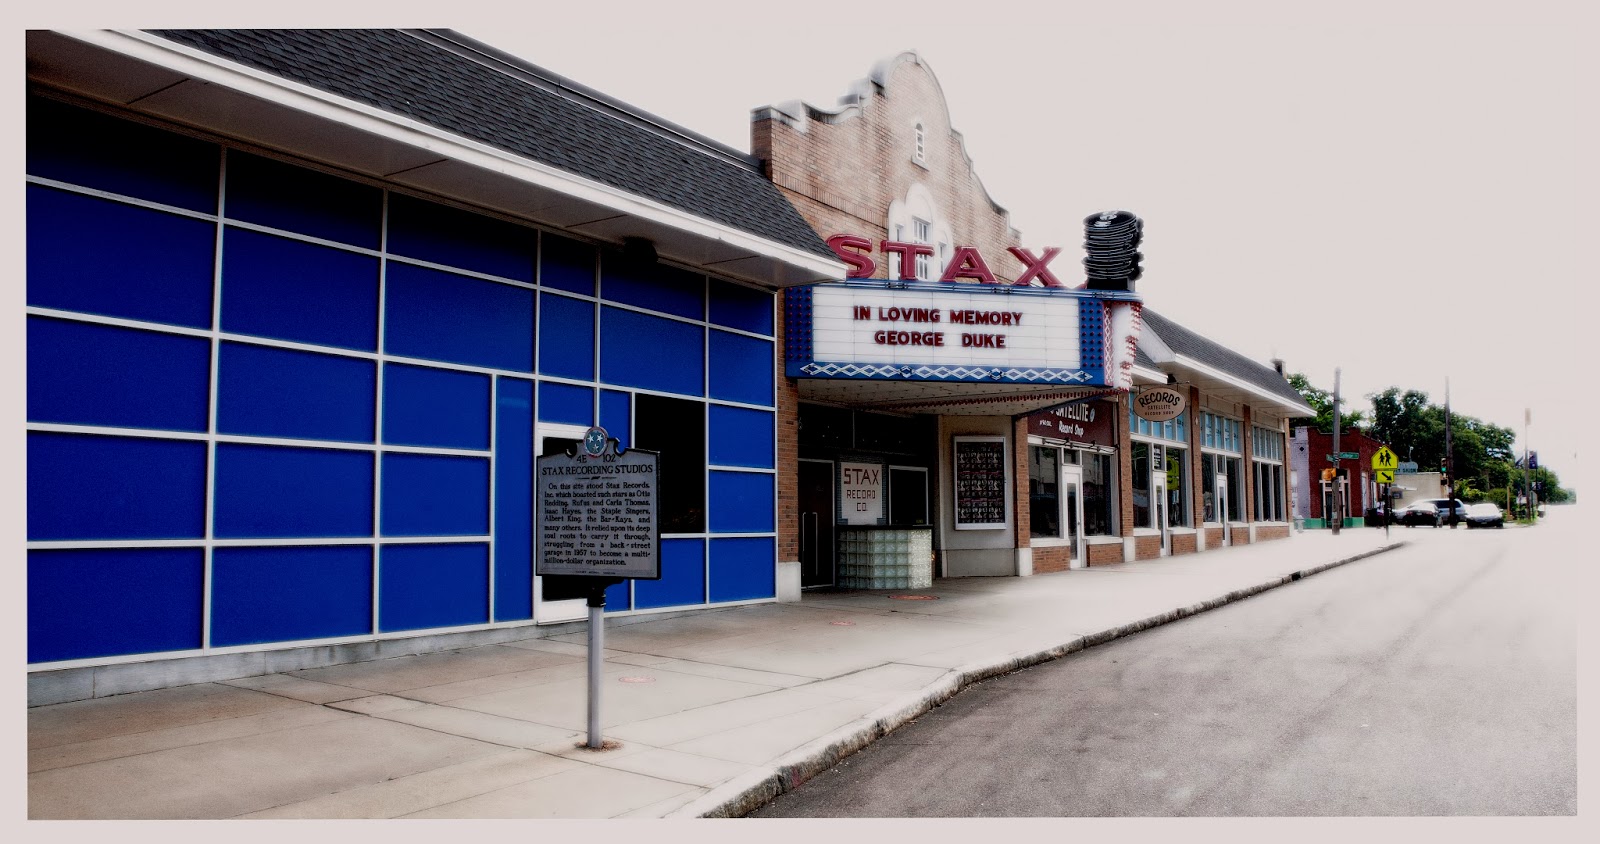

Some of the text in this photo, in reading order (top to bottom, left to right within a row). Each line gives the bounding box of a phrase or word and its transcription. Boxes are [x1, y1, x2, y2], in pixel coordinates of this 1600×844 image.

[826, 233, 1064, 287] STAX
[853, 305, 1024, 326] IN LOVING MEMORY
[874, 330, 1007, 348] GEORGE DUKE
[1138, 392, 1180, 408] RECORDS
[576, 454, 616, 464] 4E 102
[542, 464, 653, 476] STAX RECORDING STUDIOS
[844, 468, 880, 486] STAX
[846, 490, 876, 500] RECORD
[600, 508, 622, 516] Staple
[636, 524, 650, 533] deep
